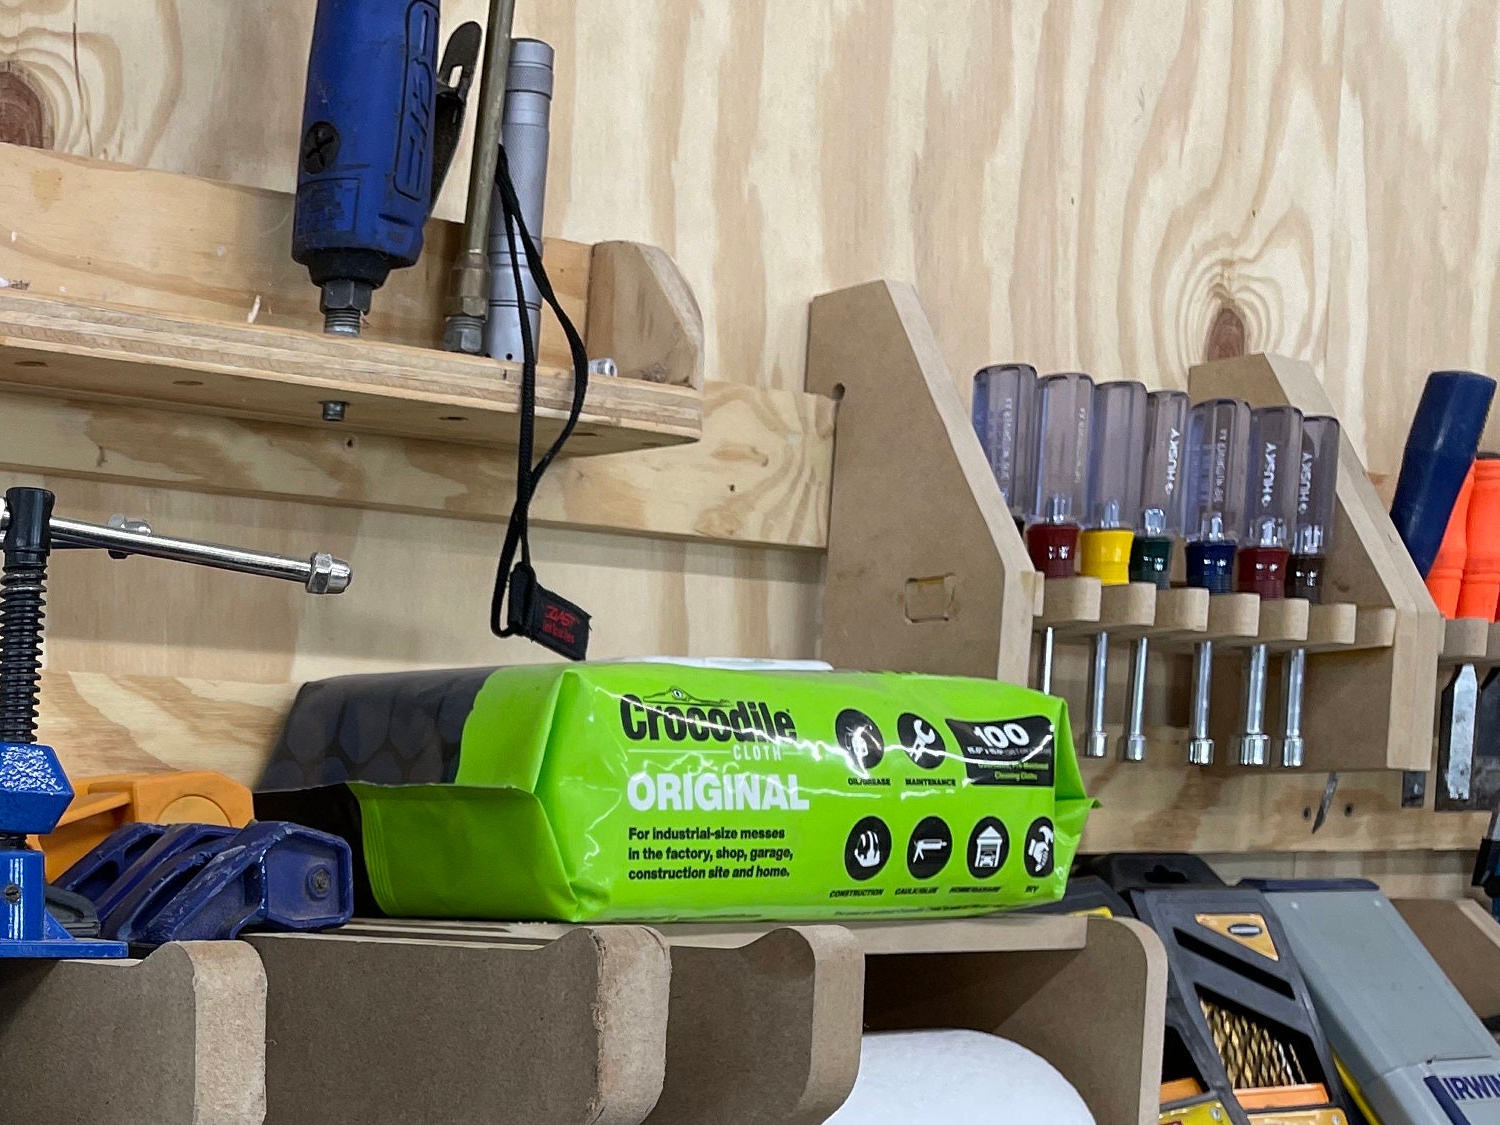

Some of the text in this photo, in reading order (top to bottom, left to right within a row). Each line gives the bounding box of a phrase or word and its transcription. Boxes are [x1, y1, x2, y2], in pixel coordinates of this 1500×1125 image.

[1166, 427, 1180, 481] HUSKY
[1262, 442, 1276, 494] HUSKY
[620, 694, 797, 742] Crocodile
[973, 723, 1029, 749] 100
[732, 745, 781, 761] CLOTH
[627, 773, 809, 811] ORIGINAL
[628, 827, 785, 841] For industrial-size messes
[628, 847, 793, 862] in the factory, shop, garage,
[628, 865, 790, 880] construction site and home.
[829, 889, 884, 898] CONSTRUCTION
[1442, 1074, 1500, 1101] IRWI
